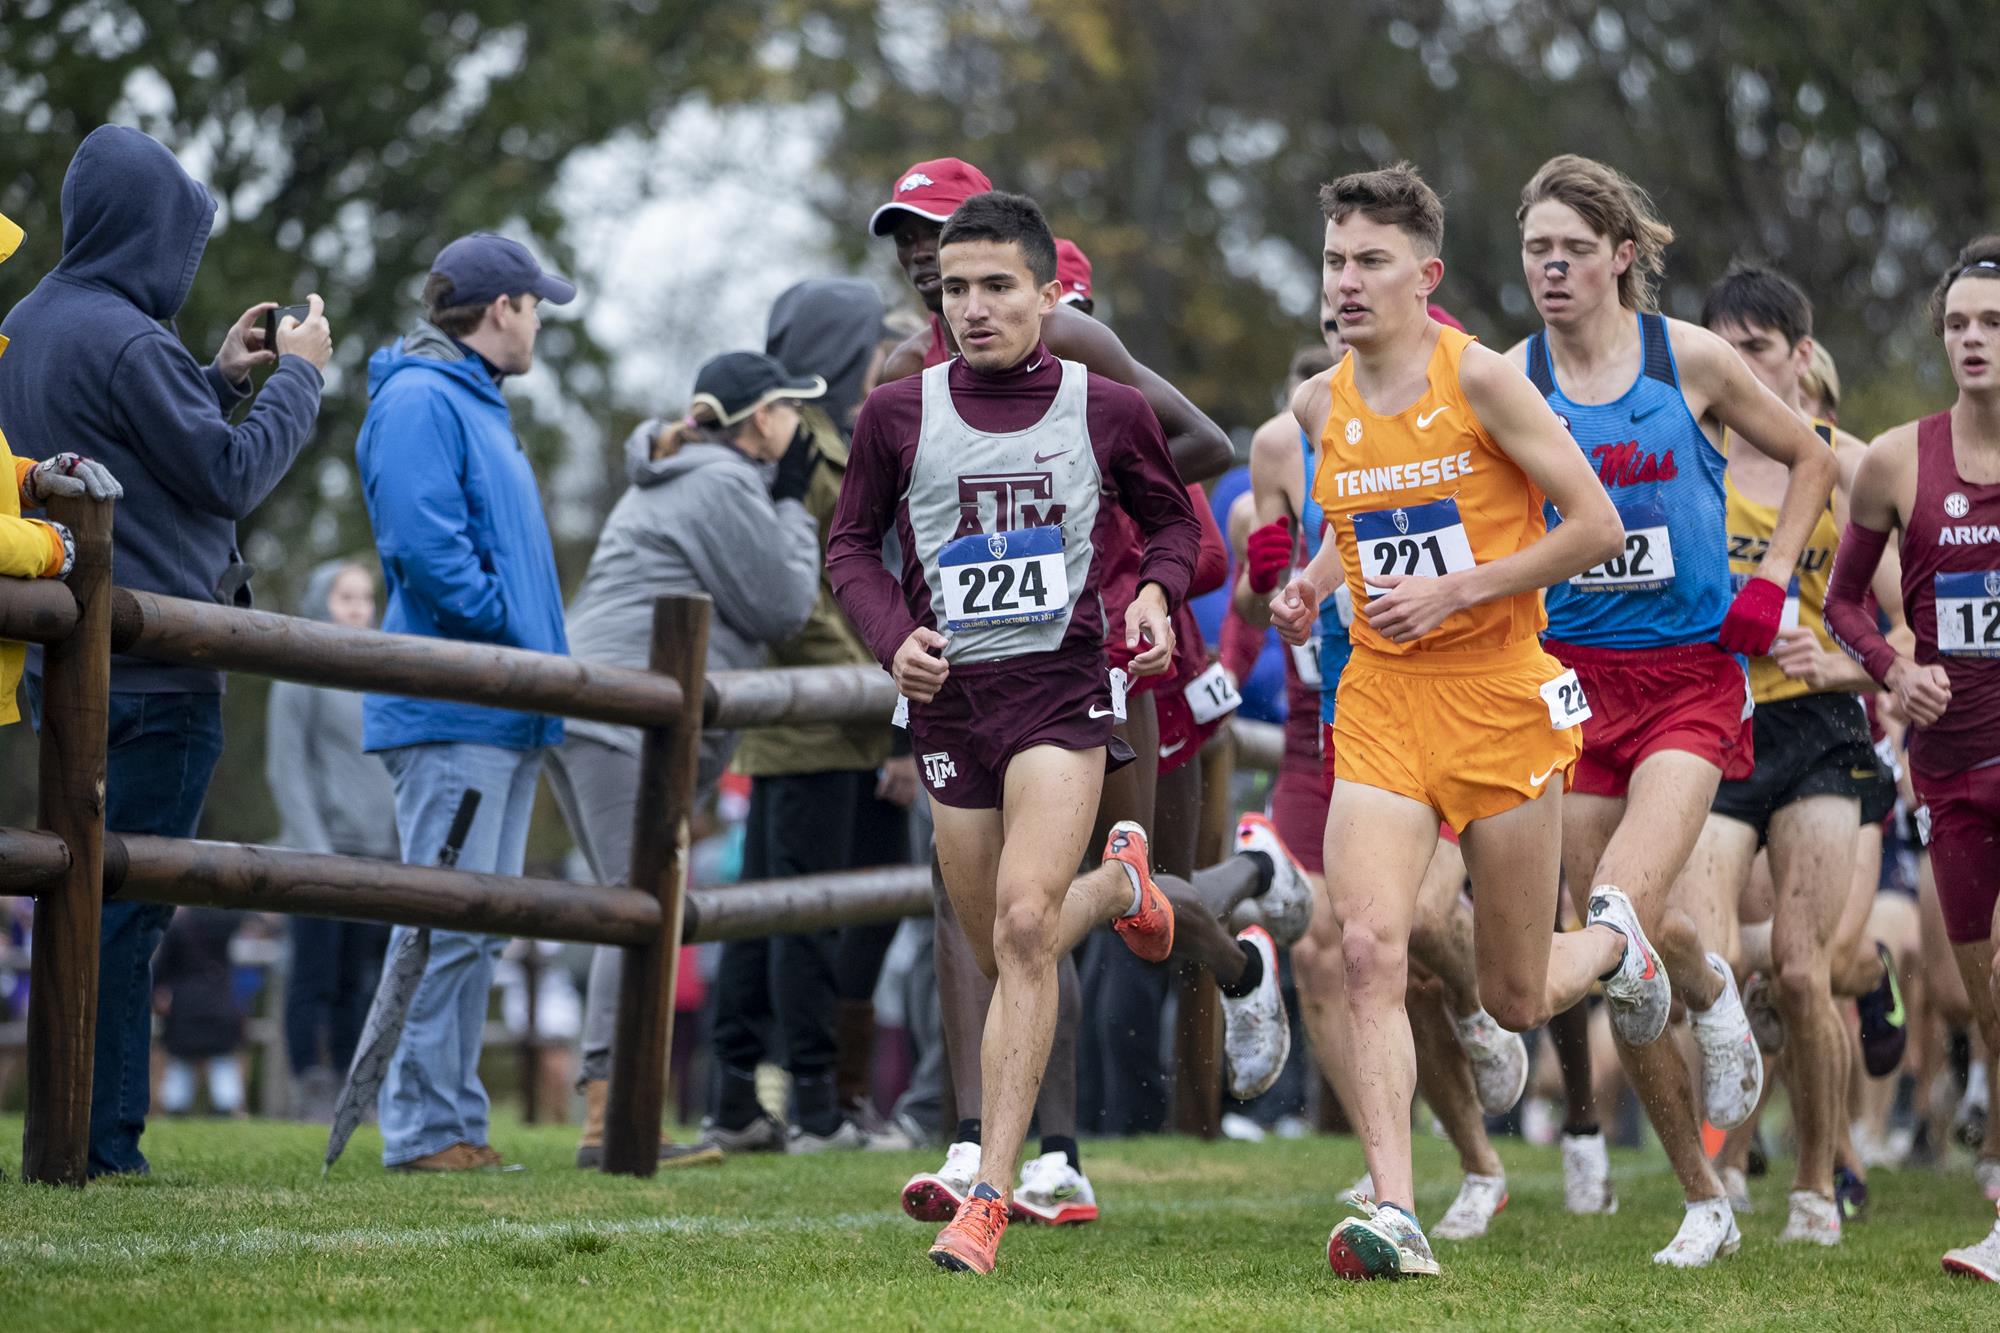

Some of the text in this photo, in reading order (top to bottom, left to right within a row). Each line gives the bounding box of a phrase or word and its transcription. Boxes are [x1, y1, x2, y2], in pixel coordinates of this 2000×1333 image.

[1345, 419, 1362, 444] SEC
[1335, 451, 1473, 497] TENNESSEE
[1591, 440, 1678, 488] Miss
[1945, 494, 1969, 517] SEC
[1938, 525, 2000, 546] ARKA
[1374, 535, 1448, 577] 221
[959, 560, 1047, 615] 224
[1956, 602, 2000, 644] 12
[1205, 676, 1233, 705] 12
[1558, 680, 1588, 716] 22
